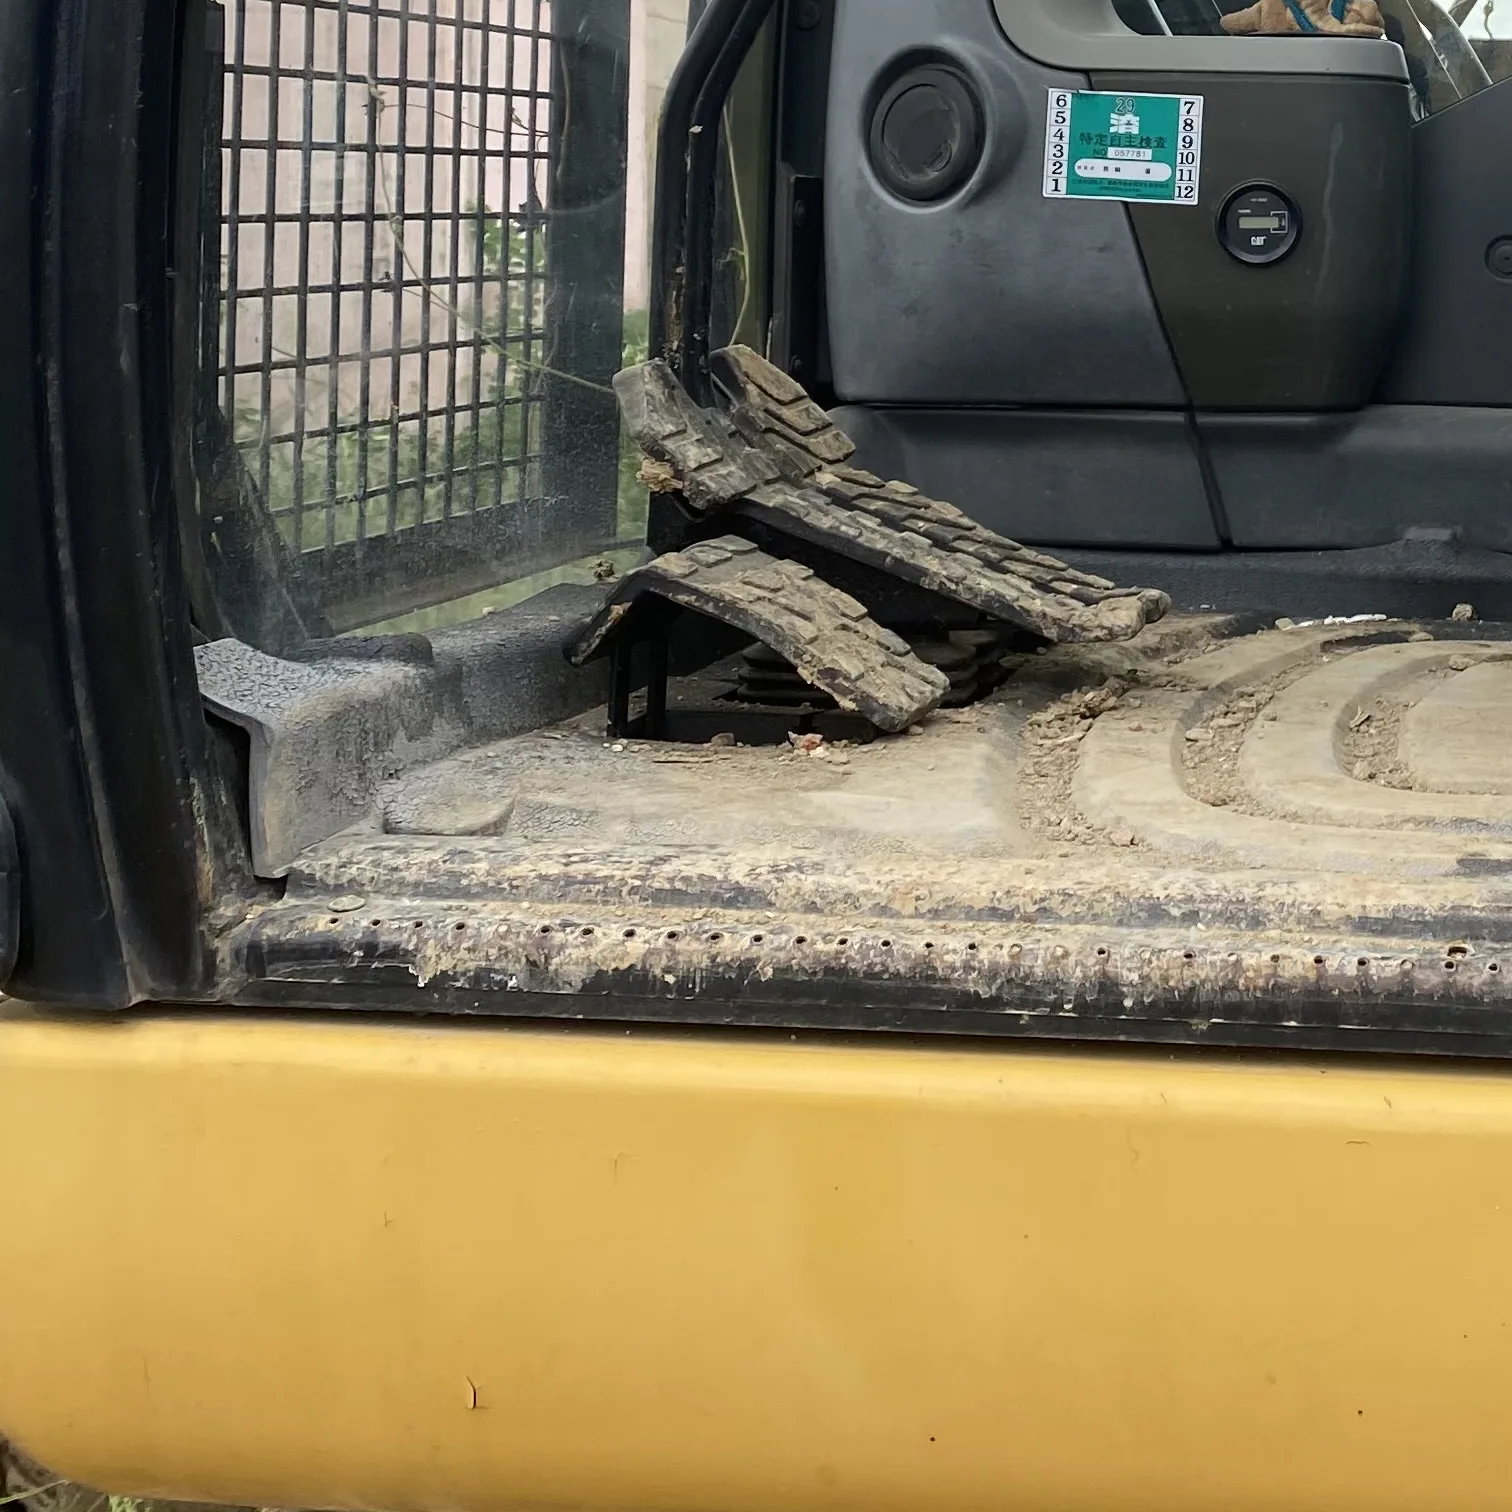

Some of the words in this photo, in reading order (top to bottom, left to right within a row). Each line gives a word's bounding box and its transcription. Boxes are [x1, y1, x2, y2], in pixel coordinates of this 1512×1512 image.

[1056, 94, 1067, 107] 6
[1115, 98, 1135, 113] 29
[1184, 101, 1195, 114] 7
[1054, 111, 1066, 124] 5
[1183, 118, 1194, 132] 8
[1053, 129, 1065, 141] 4
[1079, 132, 1167, 149] 特定自主検査
[1182, 135, 1193, 148] 9
[1053, 144, 1064, 158] 3
[1114, 149, 1146, 158] 057781
[1179, 152, 1195, 165] 10
[1052, 161, 1063, 175] 2
[1178, 168, 1192, 182] 11
[1051, 178, 1061, 192] 1
[1177, 186, 1194, 199] 12
